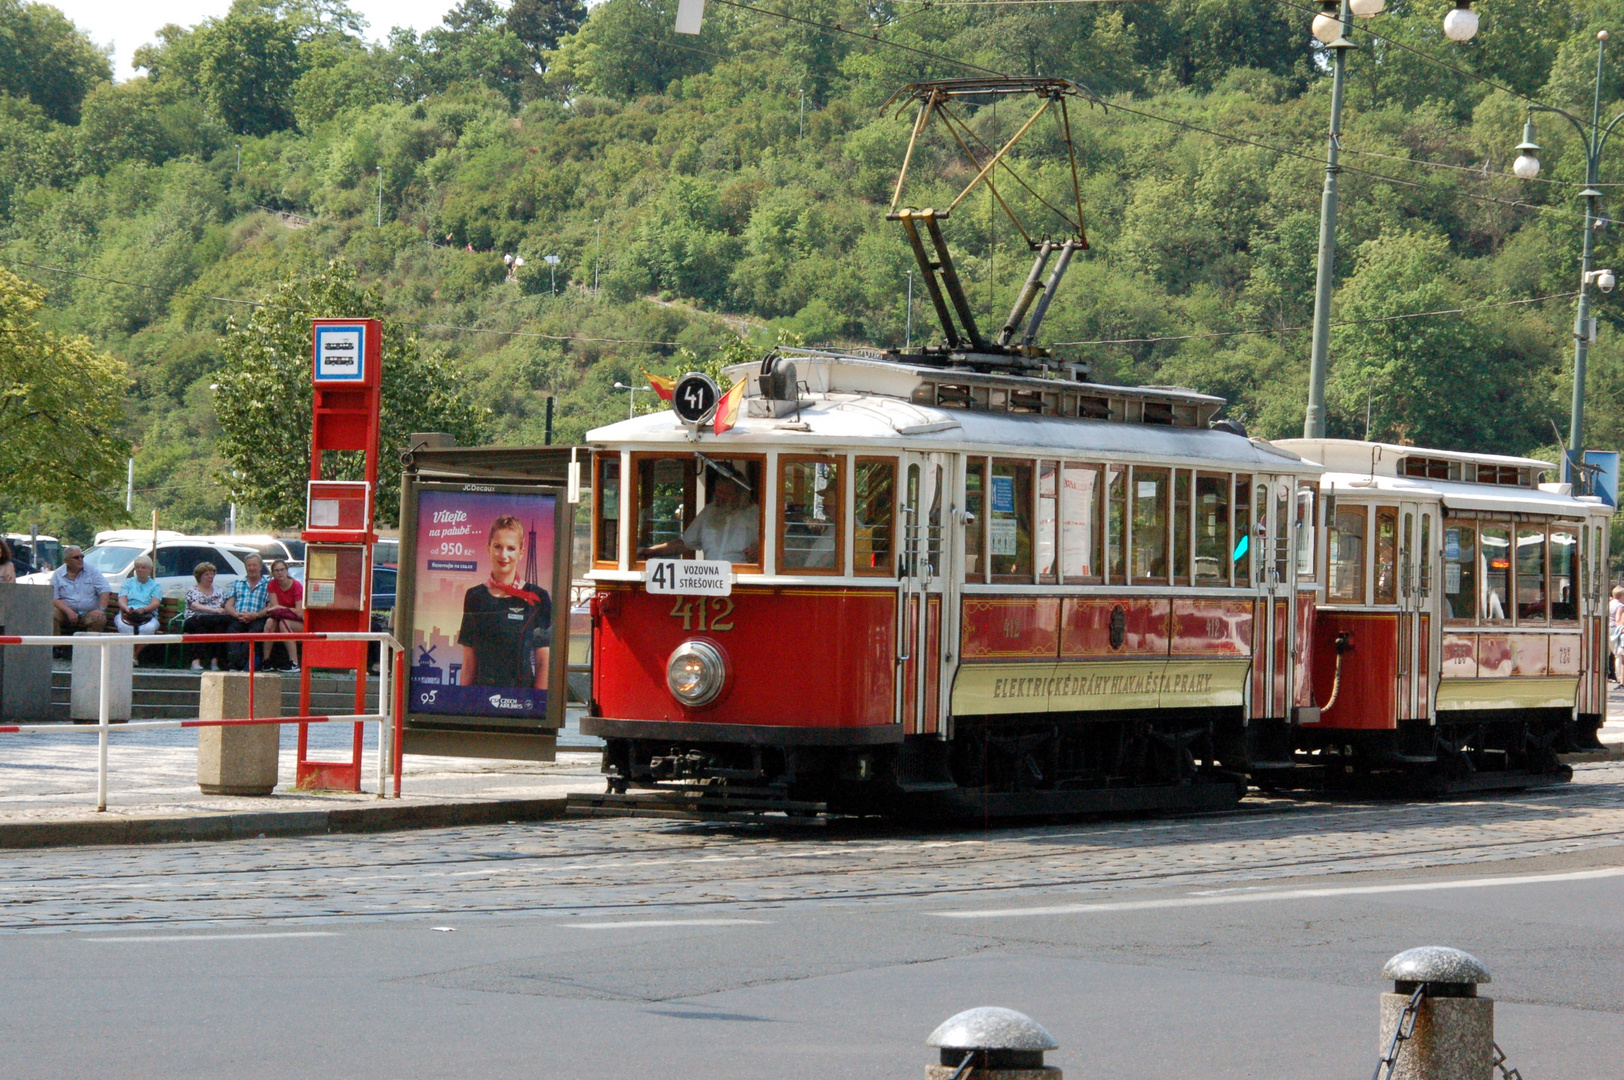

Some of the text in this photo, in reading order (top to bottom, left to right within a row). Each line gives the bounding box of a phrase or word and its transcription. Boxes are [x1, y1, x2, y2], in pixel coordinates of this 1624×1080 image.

[683, 385, 704, 409] 41
[462, 484, 496, 492] JCDecaux
[433, 509, 468, 525] Vítejte
[428, 528, 441, 537] na
[440, 542, 463, 556] 950
[651, 562, 720, 590] 41 VOZOVNA
[679, 577, 724, 589] STŘEŠOVICE
[670, 595, 735, 632] 412
[1003, 618, 1020, 638] 412
[1205, 618, 1220, 638] 412
[993, 674, 1071, 698] ELEKTRICKÉ
[1070, 673, 1111, 695] DRÁHY
